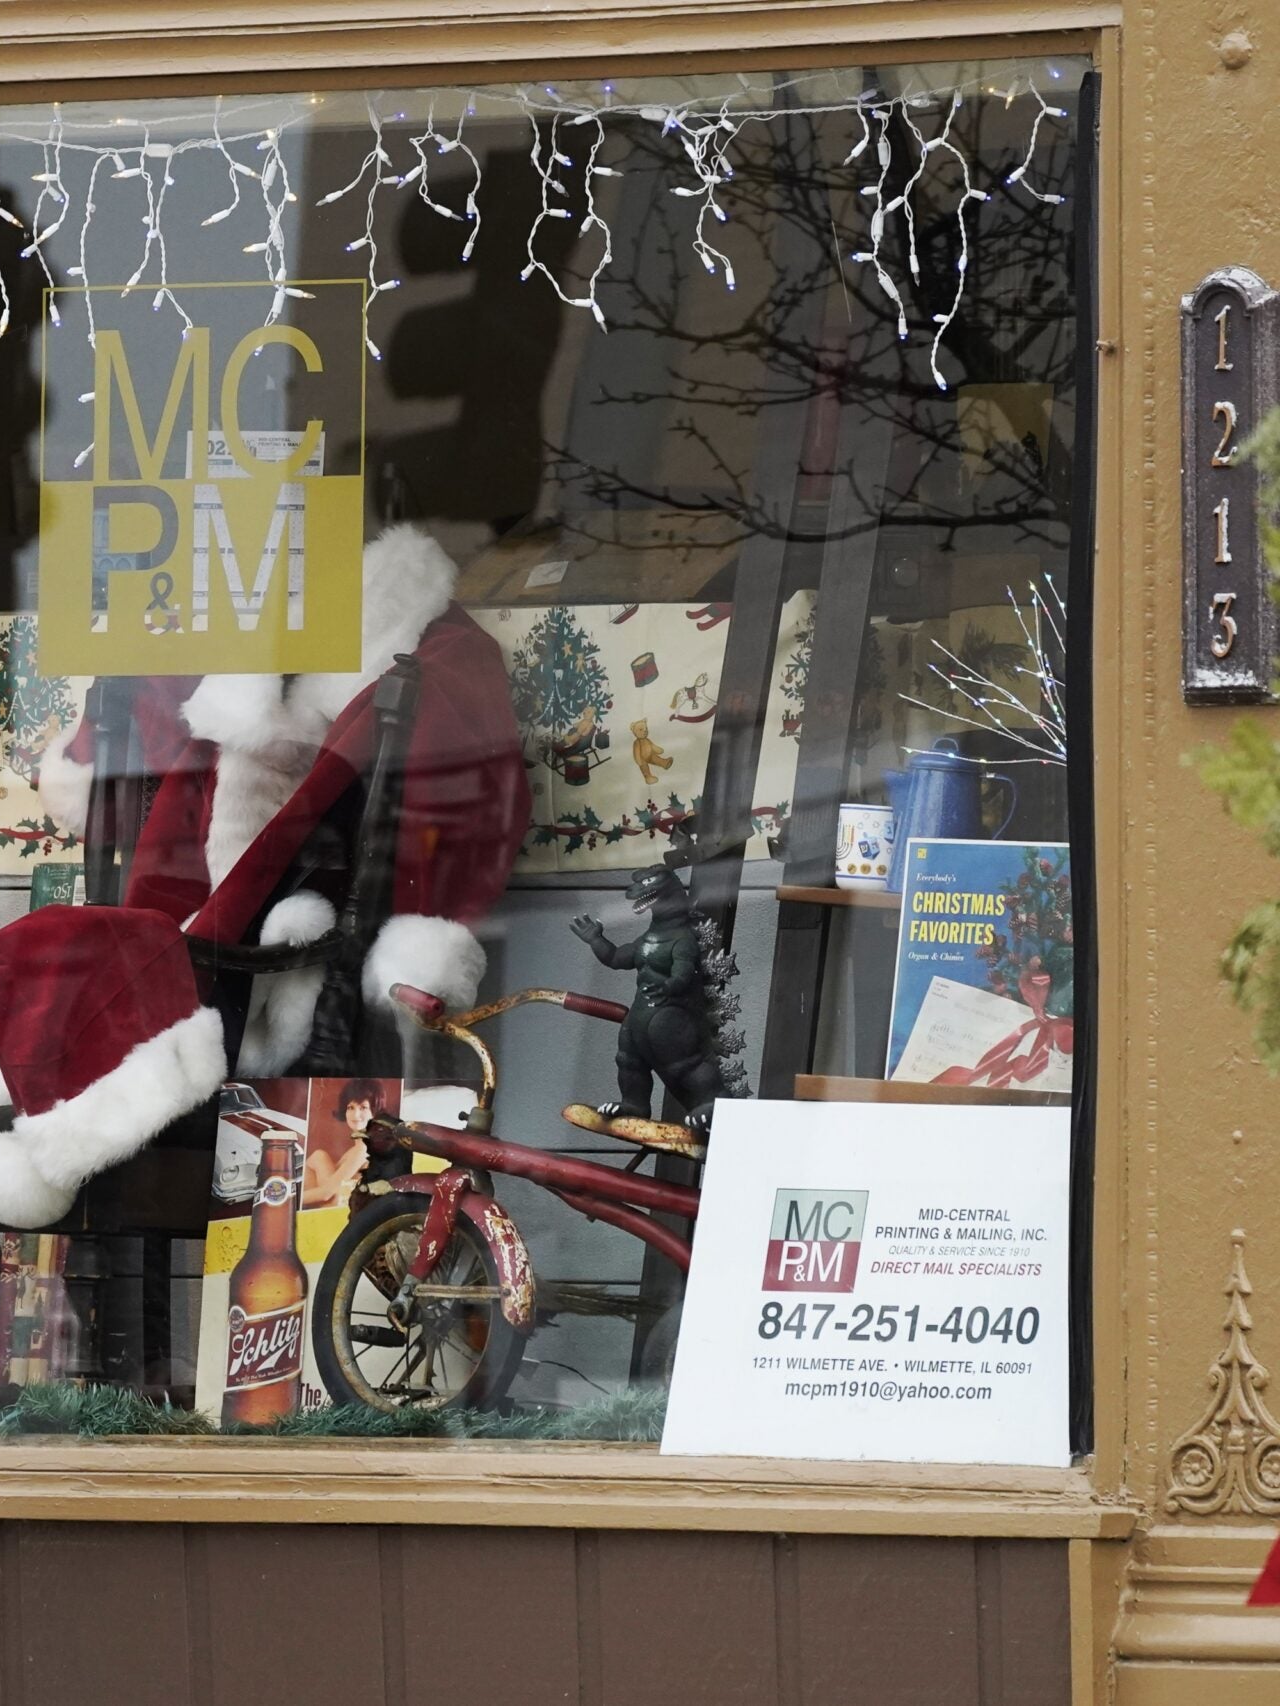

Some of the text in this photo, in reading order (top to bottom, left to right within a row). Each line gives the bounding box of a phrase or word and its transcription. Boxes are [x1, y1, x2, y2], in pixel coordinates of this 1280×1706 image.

[94, 324, 324, 481] MC
[916, 873, 957, 885] Everybody's
[912, 891, 1006, 917] CHRISTMAS
[909, 920, 995, 946] FAVORITES
[908, 951, 965, 962] Organ & Chimes
[785, 1200, 855, 1242] MC
[918, 1208, 1011, 1222] MID-CENTRAL
[875, 1226, 1048, 1242] PRINTING & MAILING, INC.
[888, 1245, 1031, 1257] QUALITY & SERVICE SINCE 1910
[777, 1241, 846, 1283] P&M
[870, 1261, 1043, 1276] DIRECT MAIL SPECIALISTS
[757, 1301, 1040, 1345] 847-251-4040
[752, 1357, 1033, 1375] 1211 WILMETTE AVE. WILMETTE, IL 60091
[784, 1381, 993, 1402] mcpm1910@yahoo.com
